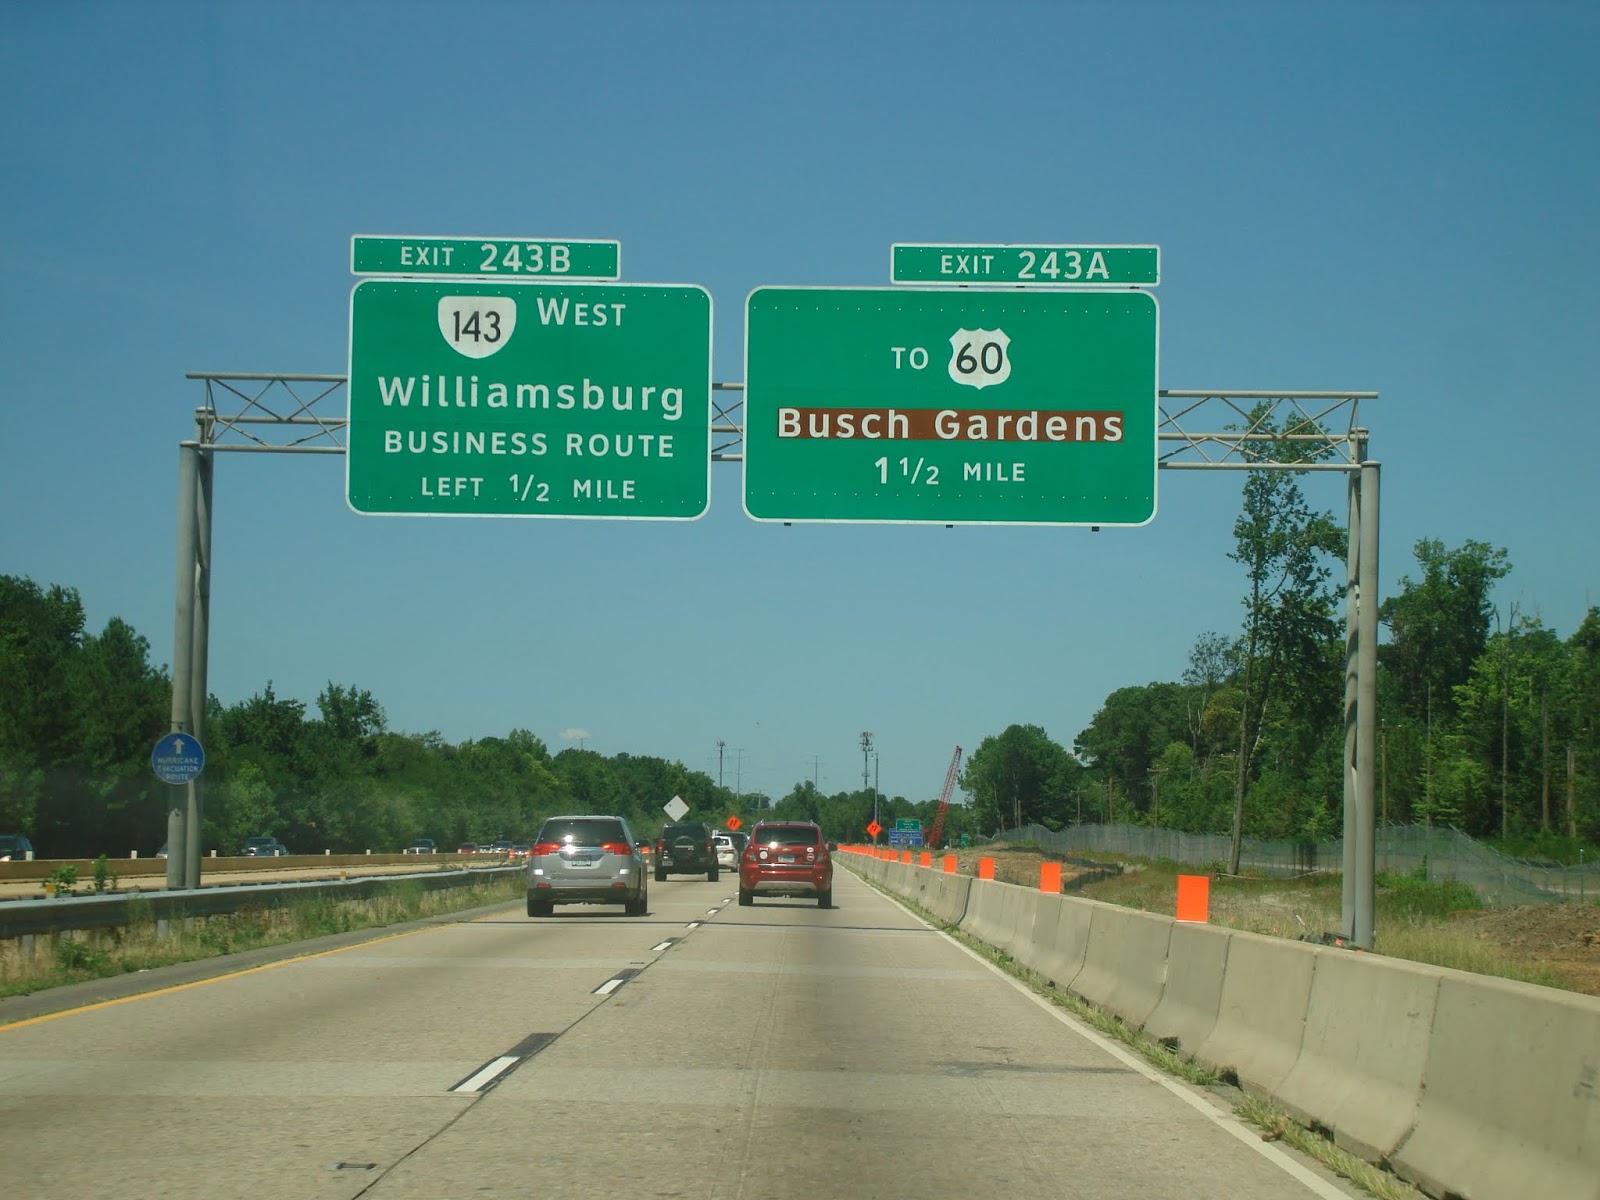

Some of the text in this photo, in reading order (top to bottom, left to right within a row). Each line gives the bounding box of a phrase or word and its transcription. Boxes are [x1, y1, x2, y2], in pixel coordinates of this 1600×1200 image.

[399, 244, 571, 273] EXIT 243B
[940, 250, 1110, 280] EXIT 243A
[452, 310, 502, 344] 143
[536, 297, 627, 327] WEST
[891, 347, 930, 370] TO
[955, 341, 1004, 375] 60
[377, 375, 684, 421] Williamsburg
[778, 408, 1123, 442] Busch Gardens
[384, 430, 674, 457] BUSINESS ROUTE
[963, 462, 1026, 482] MILE
[421, 474, 636, 502] LEFT 1/2 MILE
